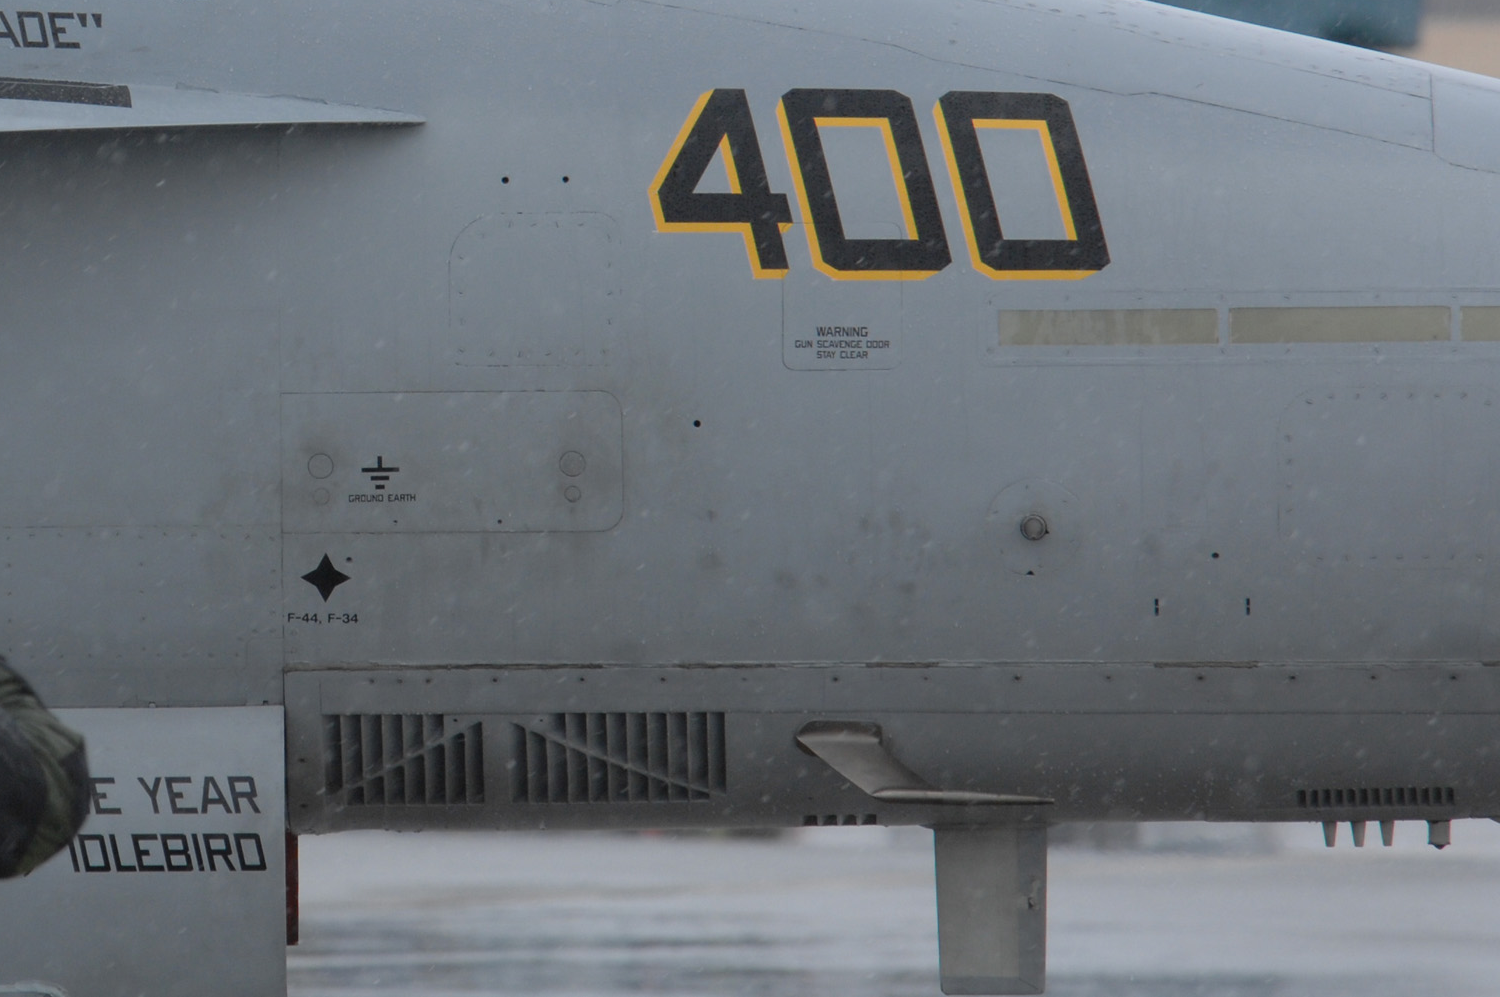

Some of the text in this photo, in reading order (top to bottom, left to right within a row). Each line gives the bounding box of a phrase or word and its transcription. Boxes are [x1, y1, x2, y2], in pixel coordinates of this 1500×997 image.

[648, 88, 1112, 281] 400
[816, 326, 868, 337] WARNING
[795, 340, 890, 348] GUN SCAVENGE DOOR
[816, 351, 868, 359] STAY CLEAR
[348, 493, 416, 503] GROUND EARTH
[287, 613, 358, 625] F-44, F-34
[137, 776, 261, 814] YEAR
